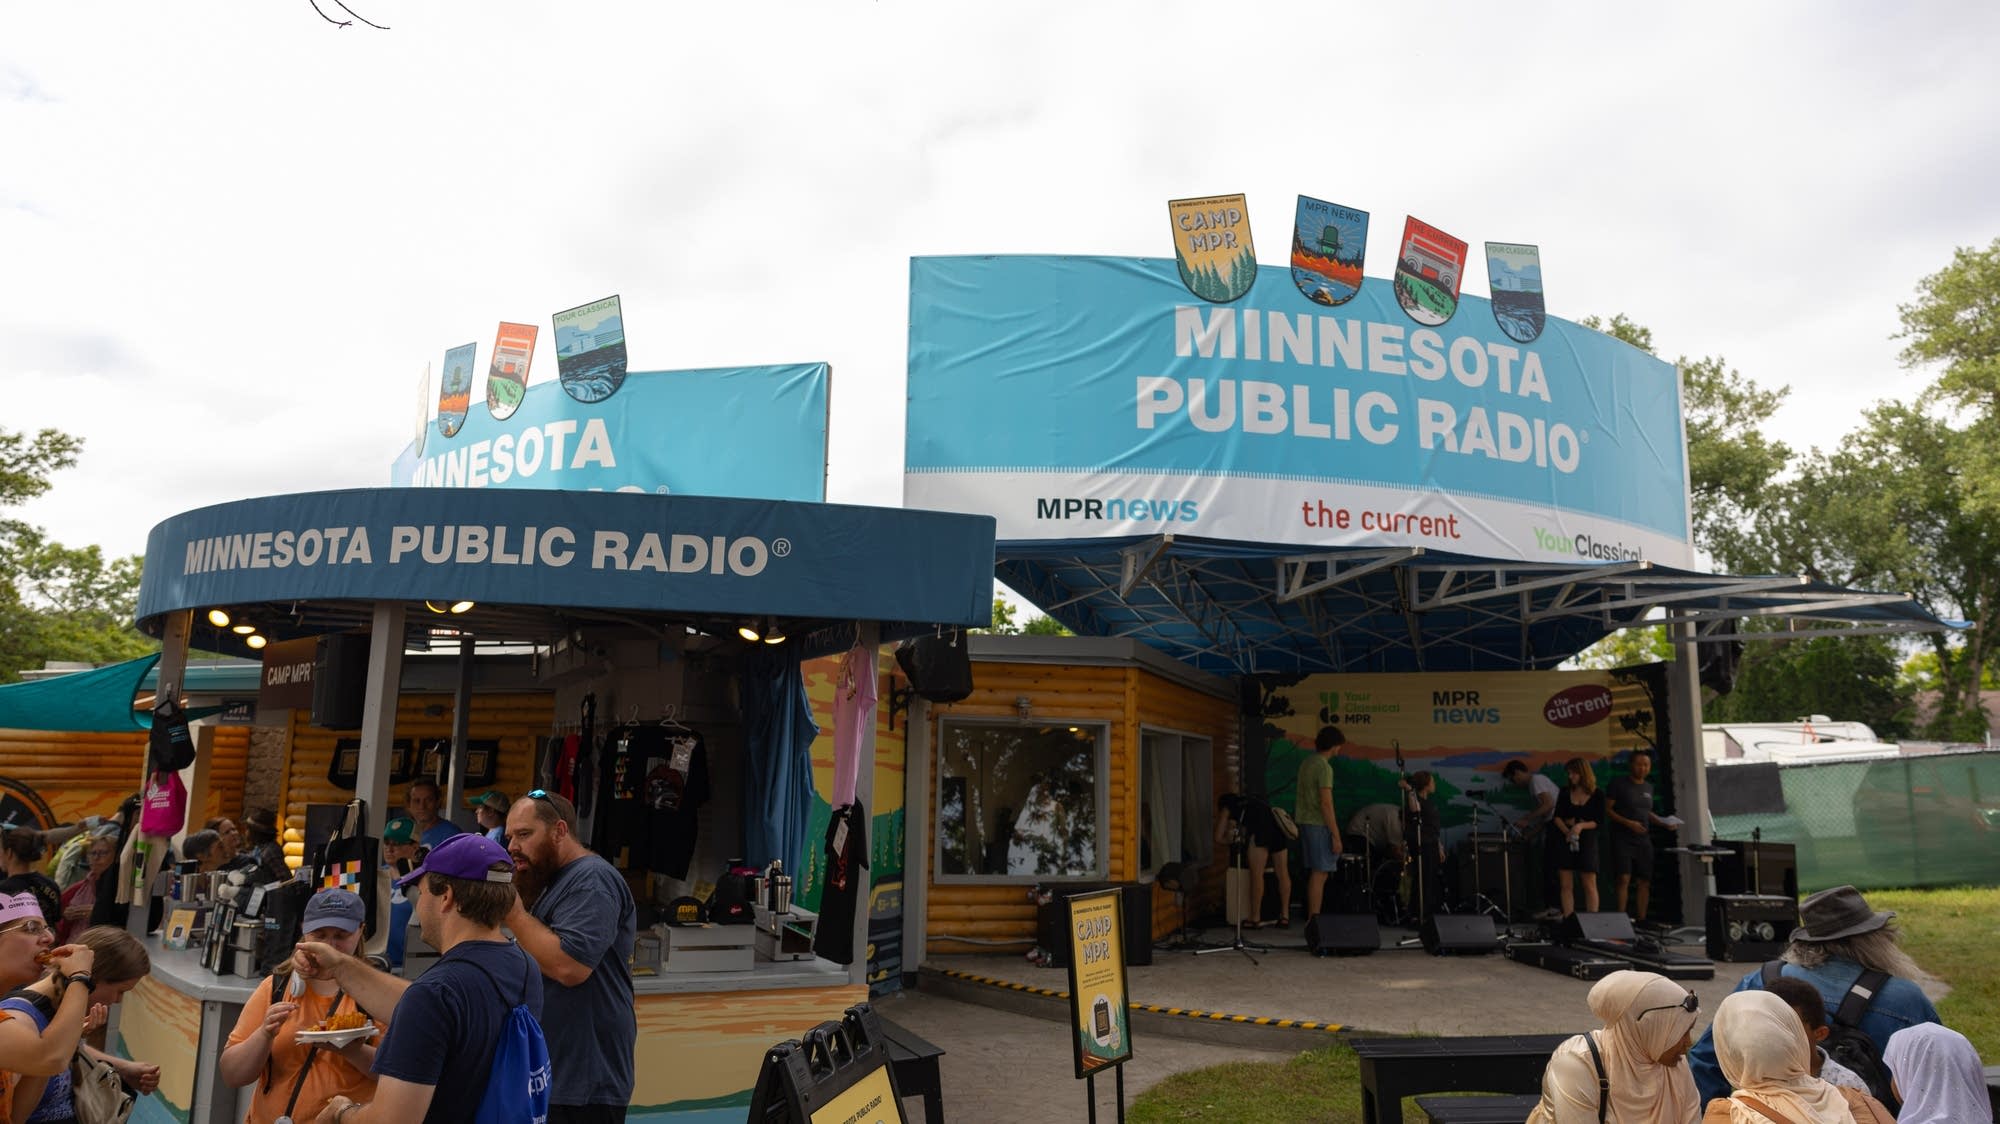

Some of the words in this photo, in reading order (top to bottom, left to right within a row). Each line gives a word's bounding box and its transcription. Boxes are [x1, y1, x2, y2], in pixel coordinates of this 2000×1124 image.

[1177, 207, 1242, 232] CAMP
[1304, 201, 1329, 216] MPR
[1331, 207, 1361, 224] NEWS
[1410, 221, 1425, 233] THE
[1188, 230, 1239, 254] MPR
[556, 312, 576, 323] YOUR
[577, 300, 617, 318] CLASSICAL
[1175, 305, 1552, 403] MINNESOTA
[1136, 375, 1399, 445] PUBLIC
[1302, 499, 1350, 530] the
[1361, 510, 1462, 540] current
[183, 526, 373, 576] MINNESOTA
[389, 524, 576, 567] PUBLIC
[267, 664, 291, 686] CAMP
[291, 661, 311, 685] MPR
[1344, 691, 1372, 702] Your
[1344, 702, 1400, 713] Classical
[1432, 690, 1480, 706] MPR
[1547, 691, 1612, 721] current
[1552, 697, 1570, 707] the
[1344, 713, 1371, 724] MPR
[1432, 707, 1501, 724] news
[1077, 915, 1112, 941] CAMP
[1083, 940, 1110, 965] MPR
